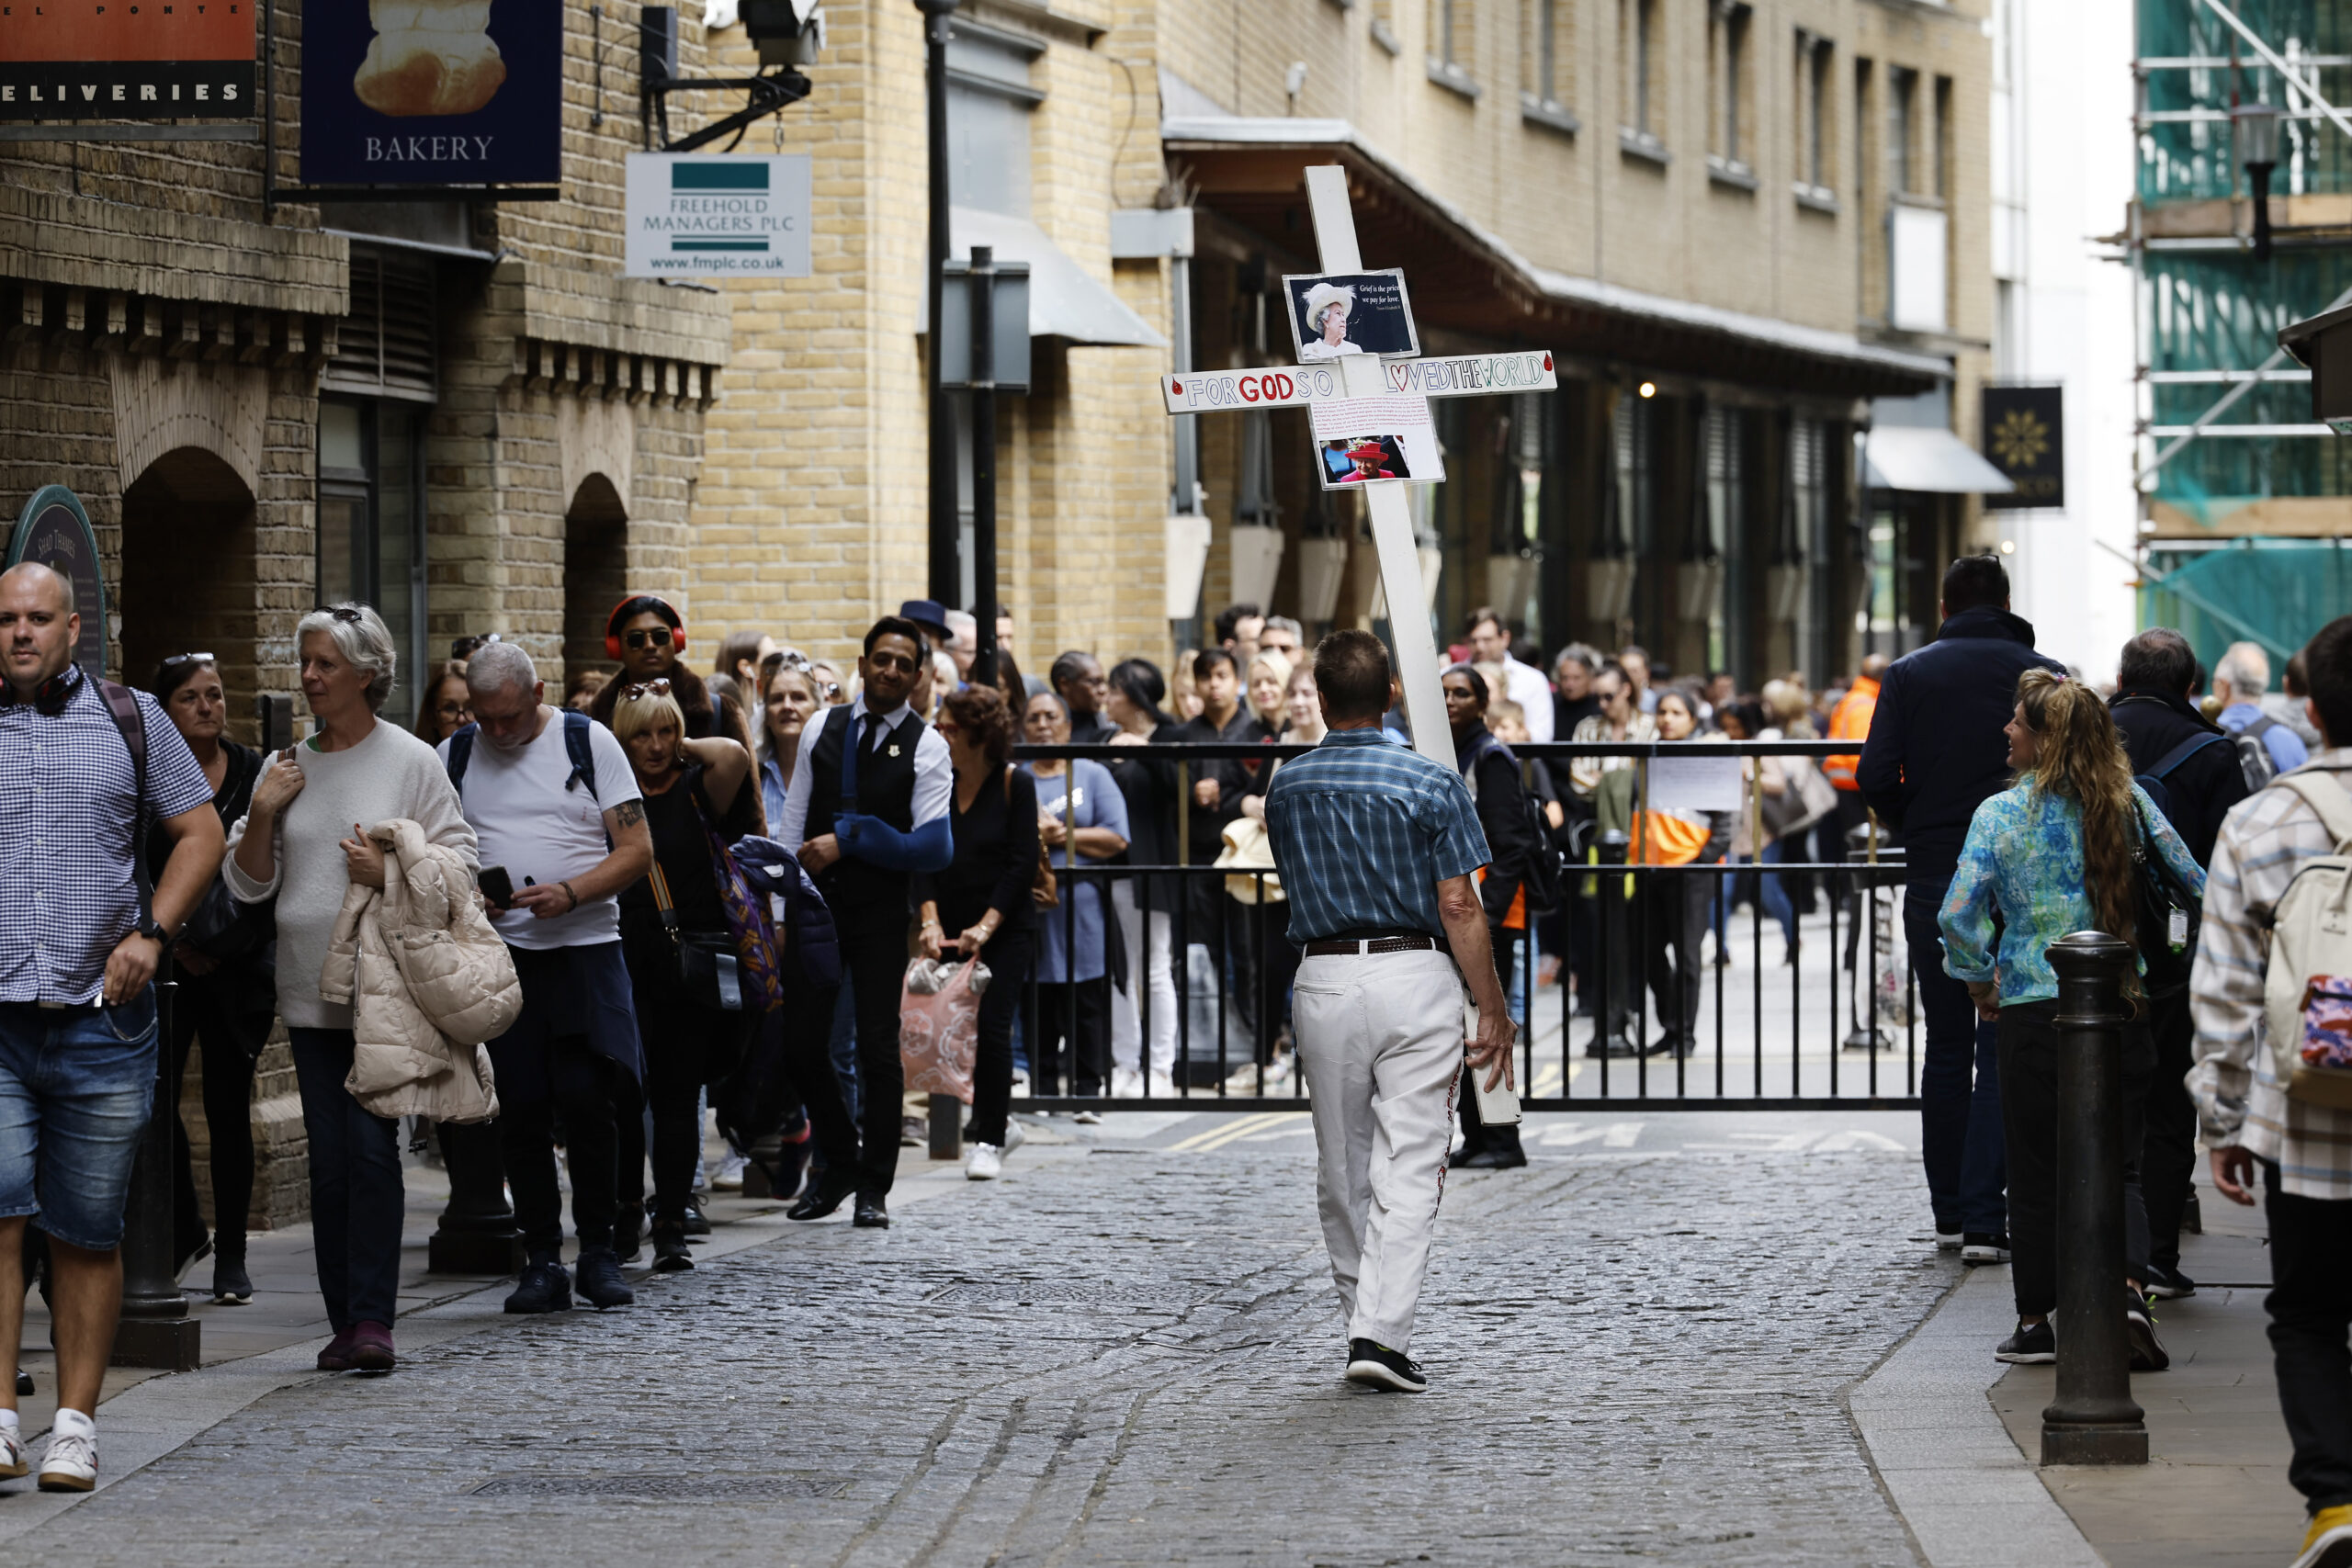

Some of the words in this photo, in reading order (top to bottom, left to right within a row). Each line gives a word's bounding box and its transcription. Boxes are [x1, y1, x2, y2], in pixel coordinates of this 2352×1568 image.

[96, 5, 238, 15] PONTE
[366, 136, 493, 162] BAKERY
[670, 198, 768, 214] FREEHOLD
[643, 216, 753, 231] MANAGERS
[761, 216, 795, 231] PLC
[650, 256, 785, 271] www.fmplc.co.uk
[1360, 285, 1373, 293] Grief
[1185, 377, 1238, 407] FOR
[1238, 373, 1294, 402] GOD
[1295, 370, 1333, 398] SO
[1445, 359, 1482, 389] THE
[1476, 355, 1544, 388] WORLD
[38, 534, 53, 559] SHAD
